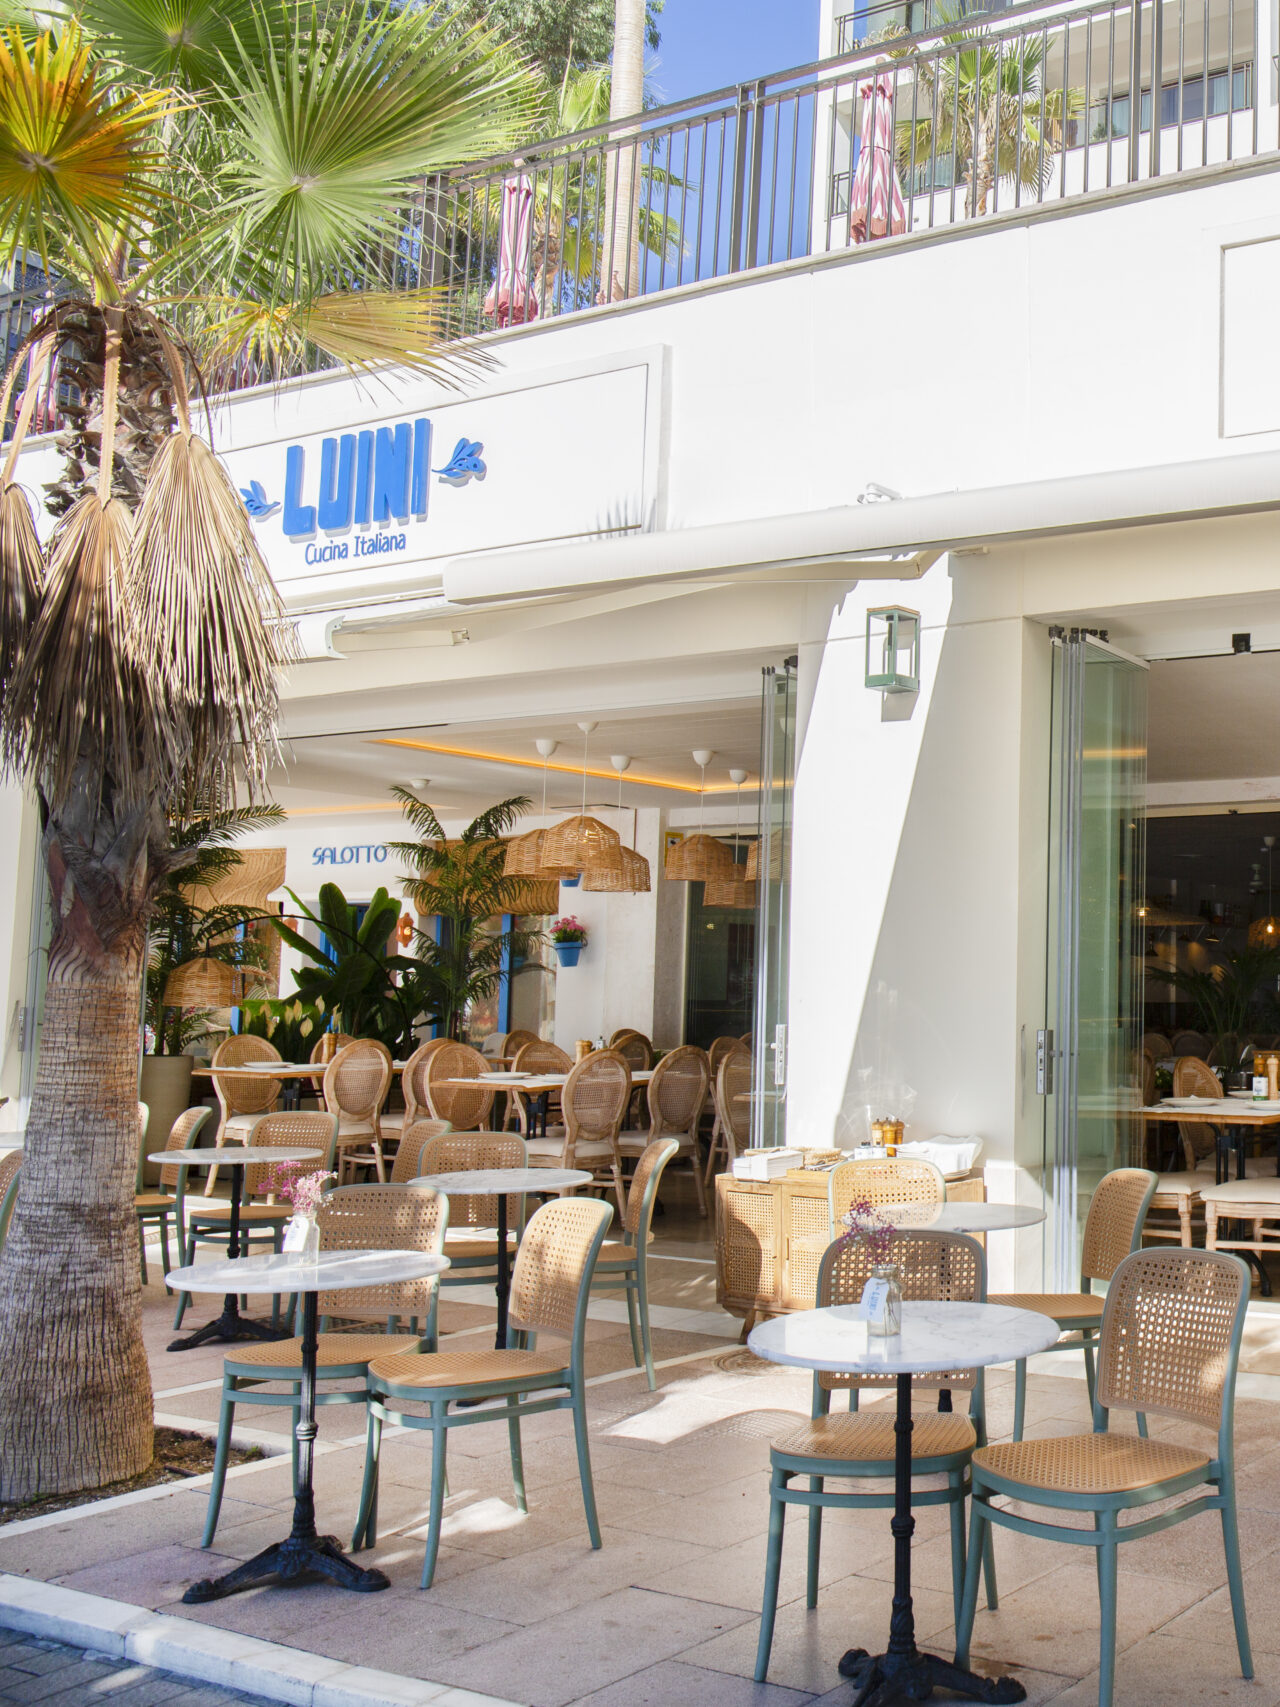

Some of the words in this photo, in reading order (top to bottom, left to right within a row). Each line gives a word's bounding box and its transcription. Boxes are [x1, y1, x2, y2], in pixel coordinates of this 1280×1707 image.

[283, 418, 431, 536] LUINI
[305, 541, 348, 565] Cucina
[353, 532, 406, 557] Italiana
[312, 845, 387, 865] SALOTTO
